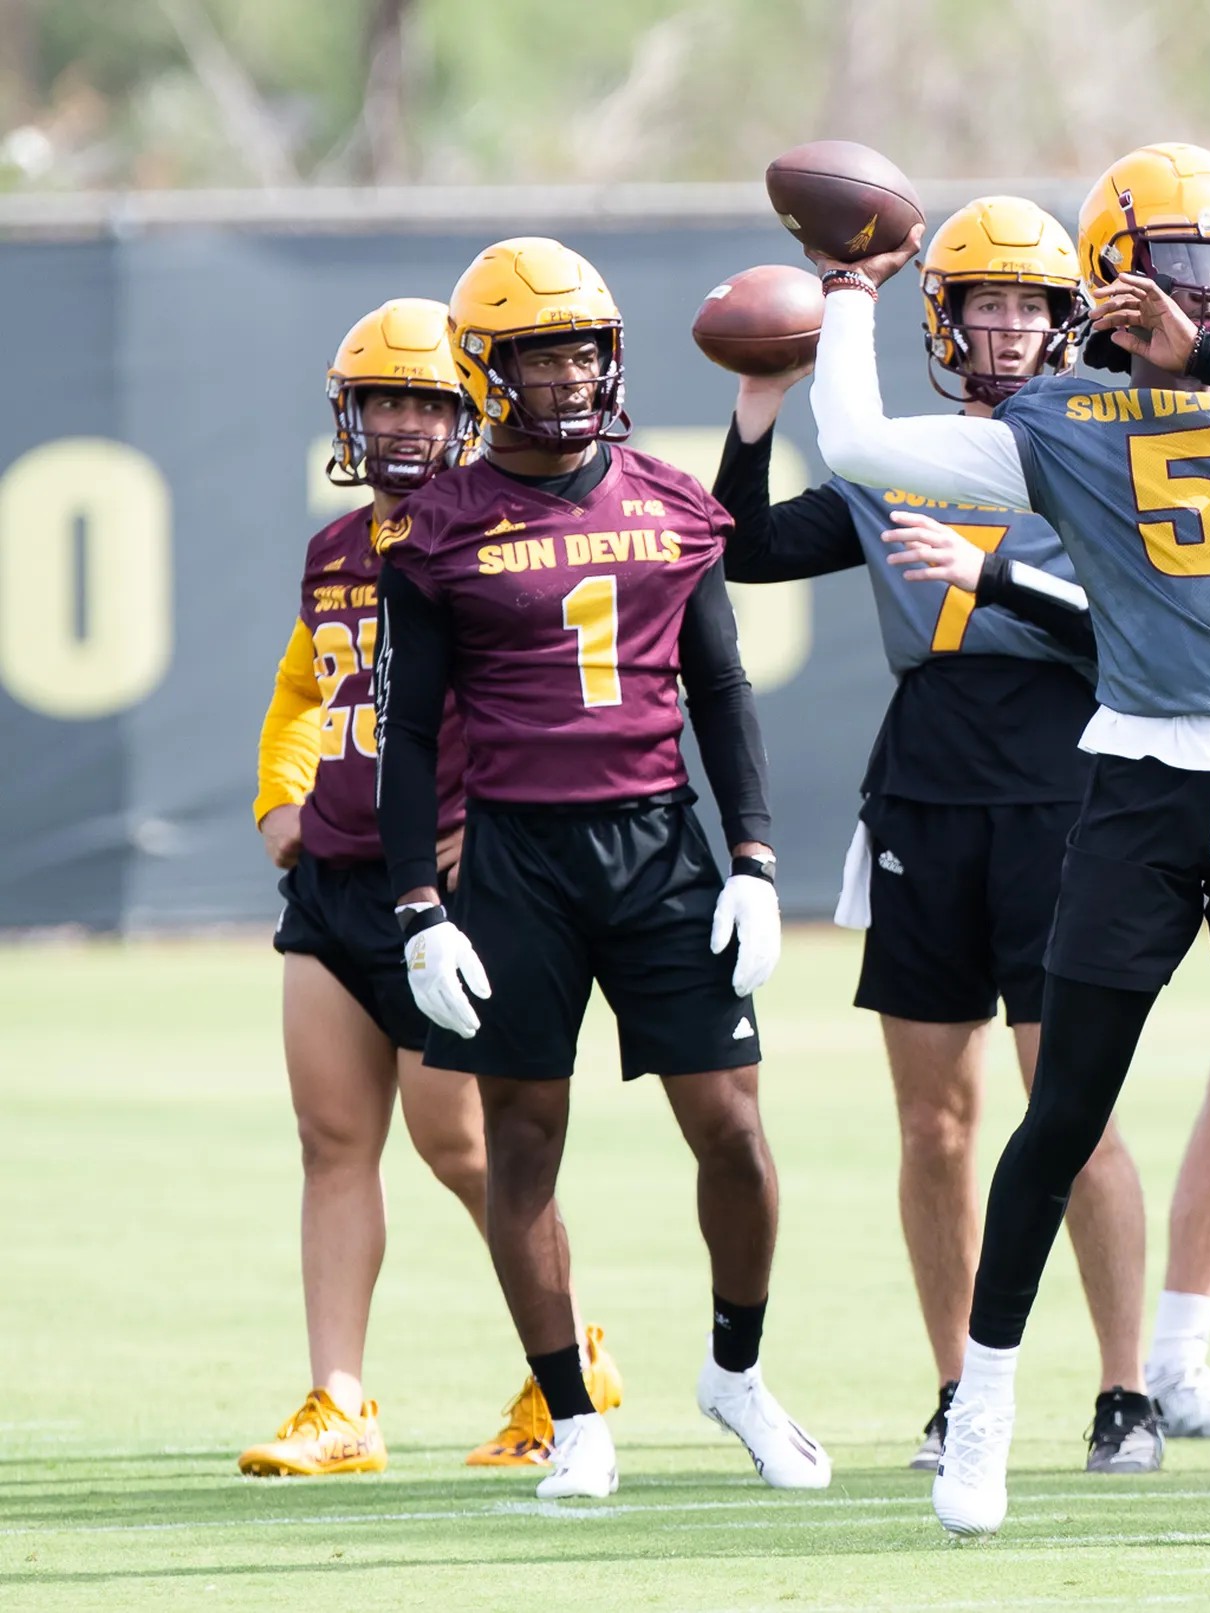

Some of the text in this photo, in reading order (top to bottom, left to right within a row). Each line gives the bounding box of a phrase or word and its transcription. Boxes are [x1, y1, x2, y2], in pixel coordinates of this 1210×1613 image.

[1065, 388, 1143, 423] SUN
[477, 530, 682, 575] SUN DEVILS
[928, 521, 1011, 654] 7
[562, 574, 622, 708] 1
